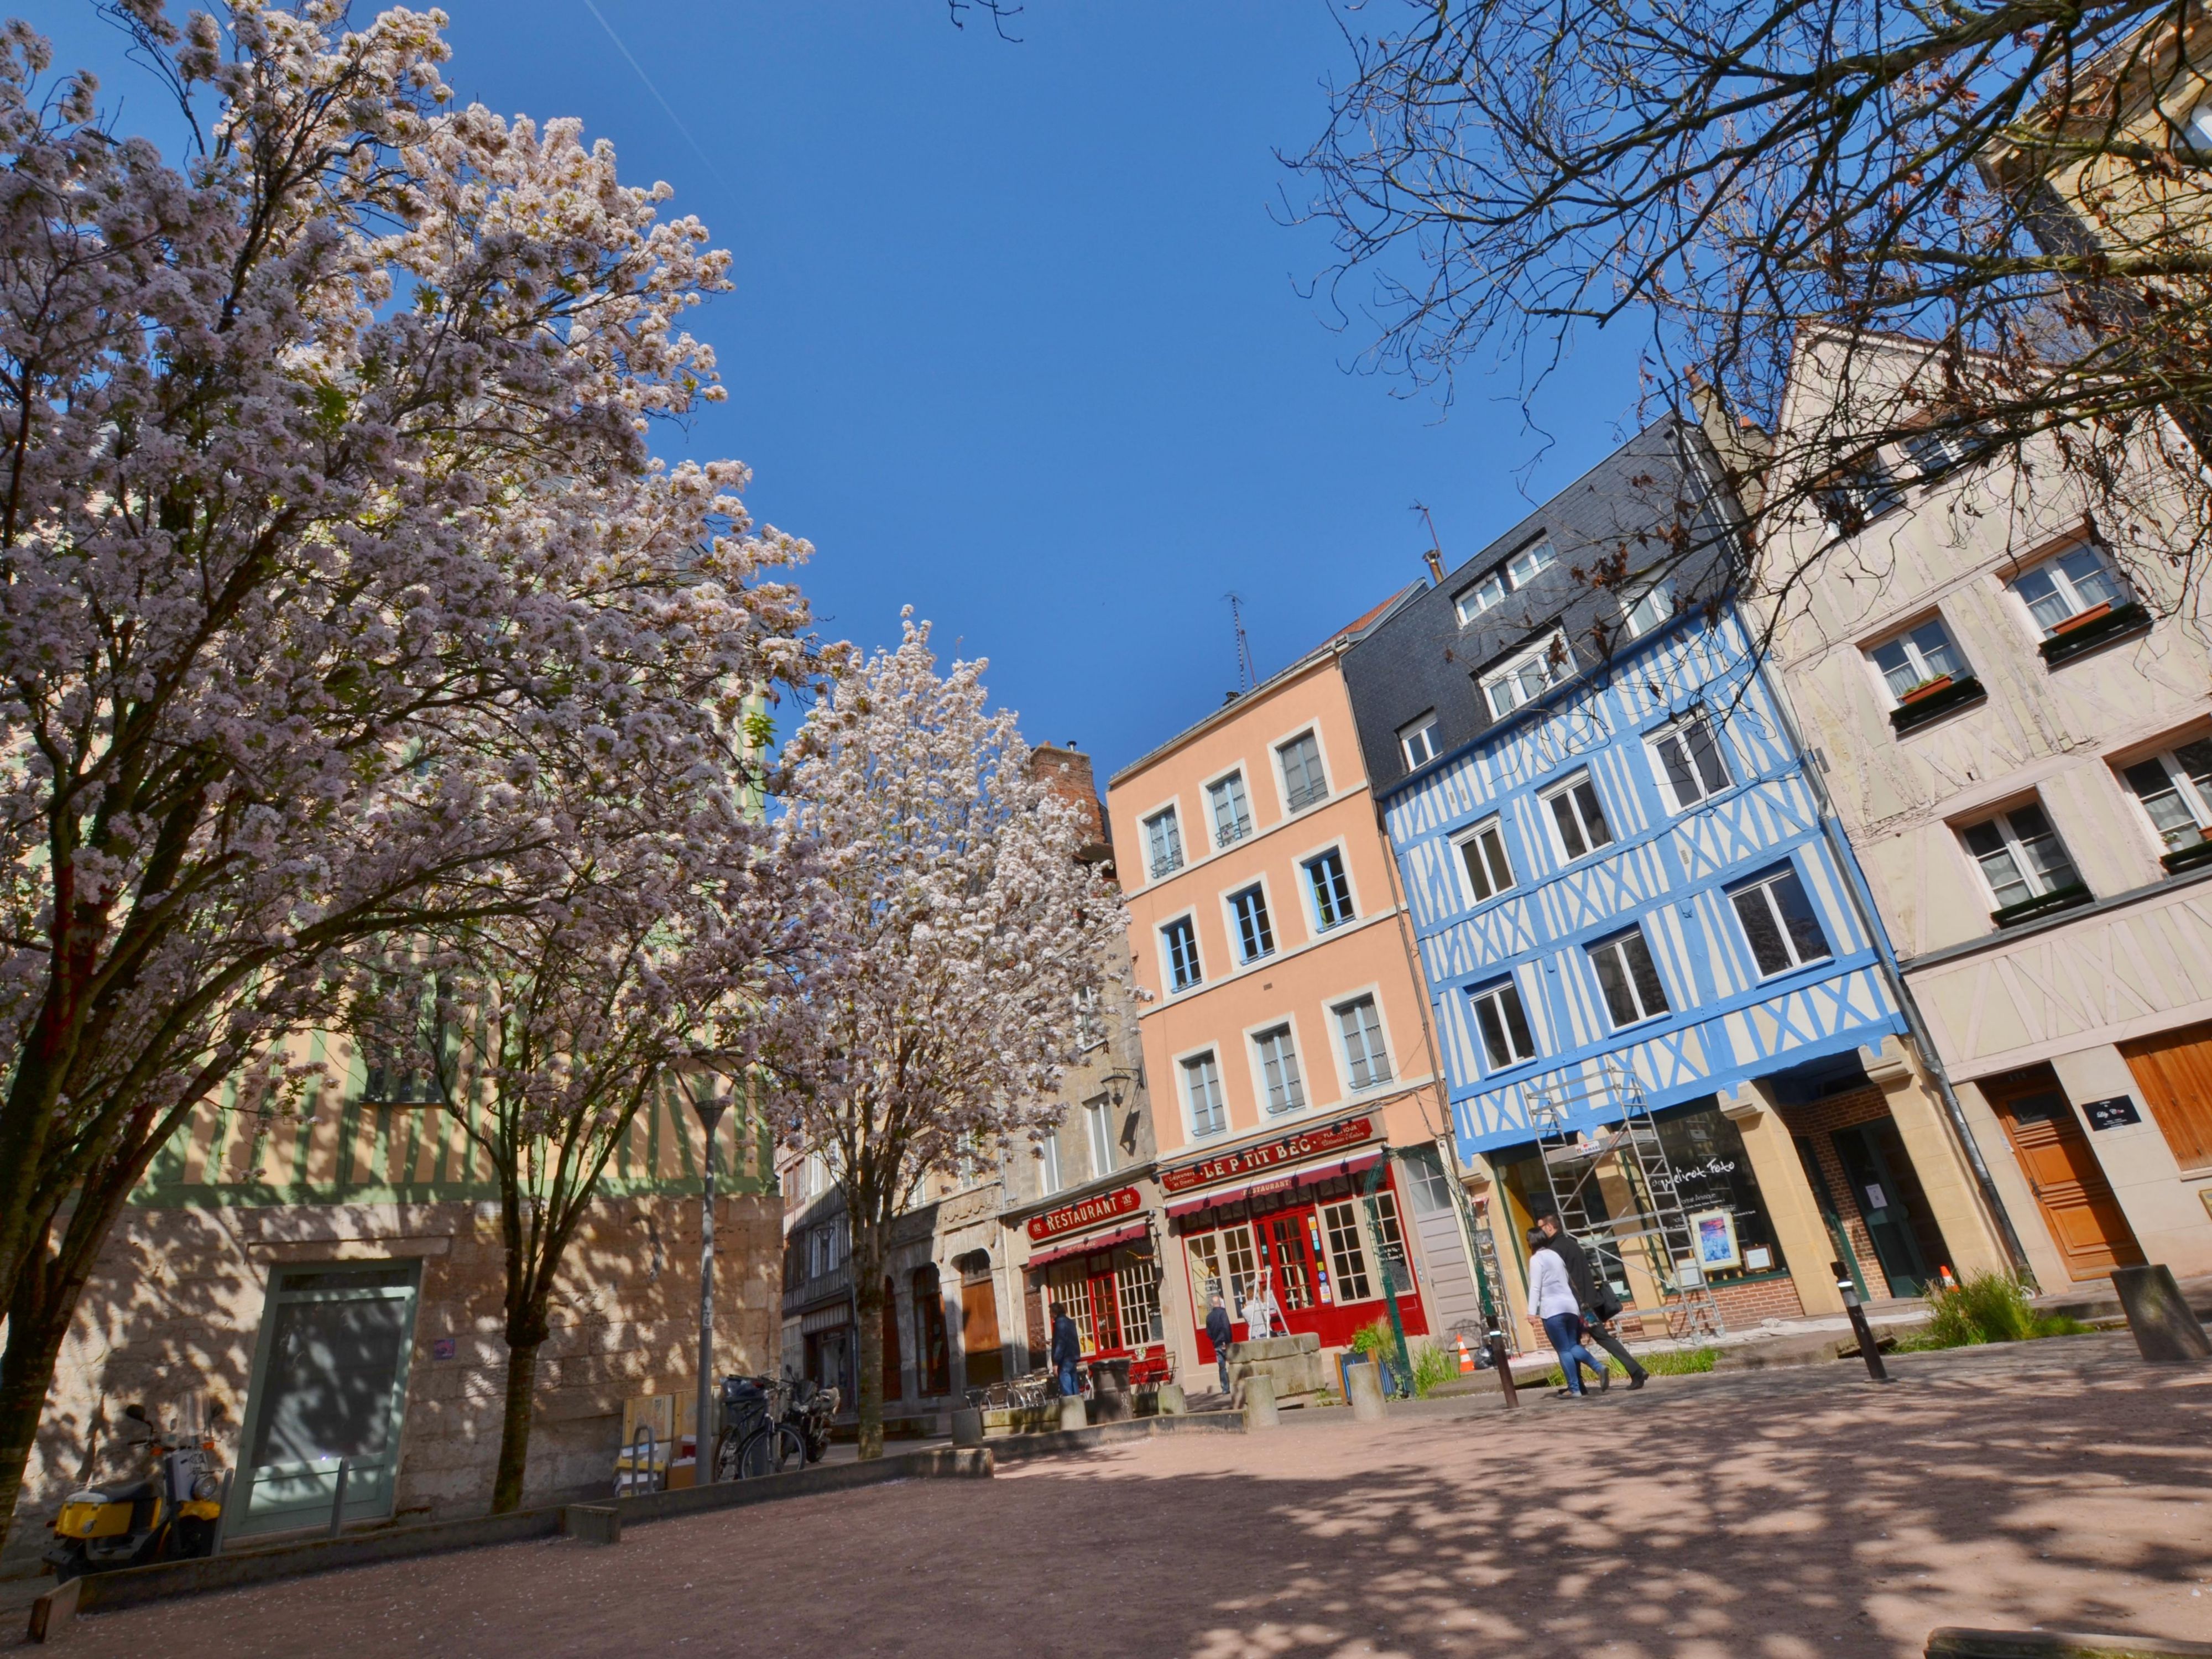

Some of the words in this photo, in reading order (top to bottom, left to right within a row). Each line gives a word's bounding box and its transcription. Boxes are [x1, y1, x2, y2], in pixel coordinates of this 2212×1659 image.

[1204, 1163, 1225, 1178] LE
[1229, 1149, 1270, 1171] PTIT
[1275, 1139, 1311, 1159] BEC
[1651, 1167, 1707, 1192] oquelicot
[1707, 1158, 1735, 1173] Foto
[1243, 1180, 1289, 1196] RSTAURANT
[1047, 1197, 1117, 1231] RESTAURANT
